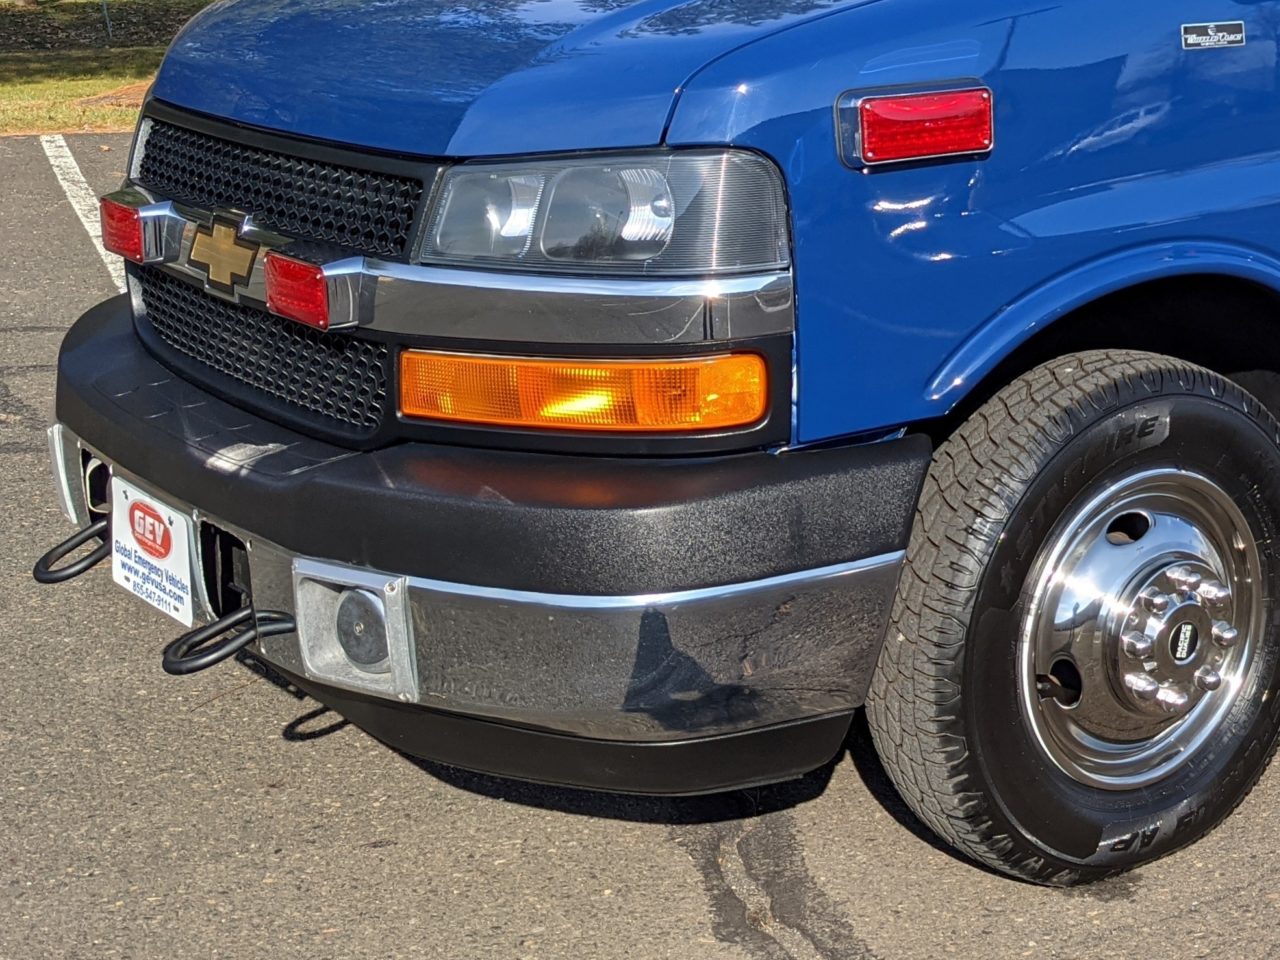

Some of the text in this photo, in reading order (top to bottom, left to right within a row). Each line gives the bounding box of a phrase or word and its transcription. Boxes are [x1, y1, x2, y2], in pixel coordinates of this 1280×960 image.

[133, 509, 165, 546] GEV
[114, 539, 133, 564] Global
[134, 550, 164, 583] Emergency
[164, 568, 189, 596] Vehicles
[120, 559, 185, 606] www.gevusa.com
